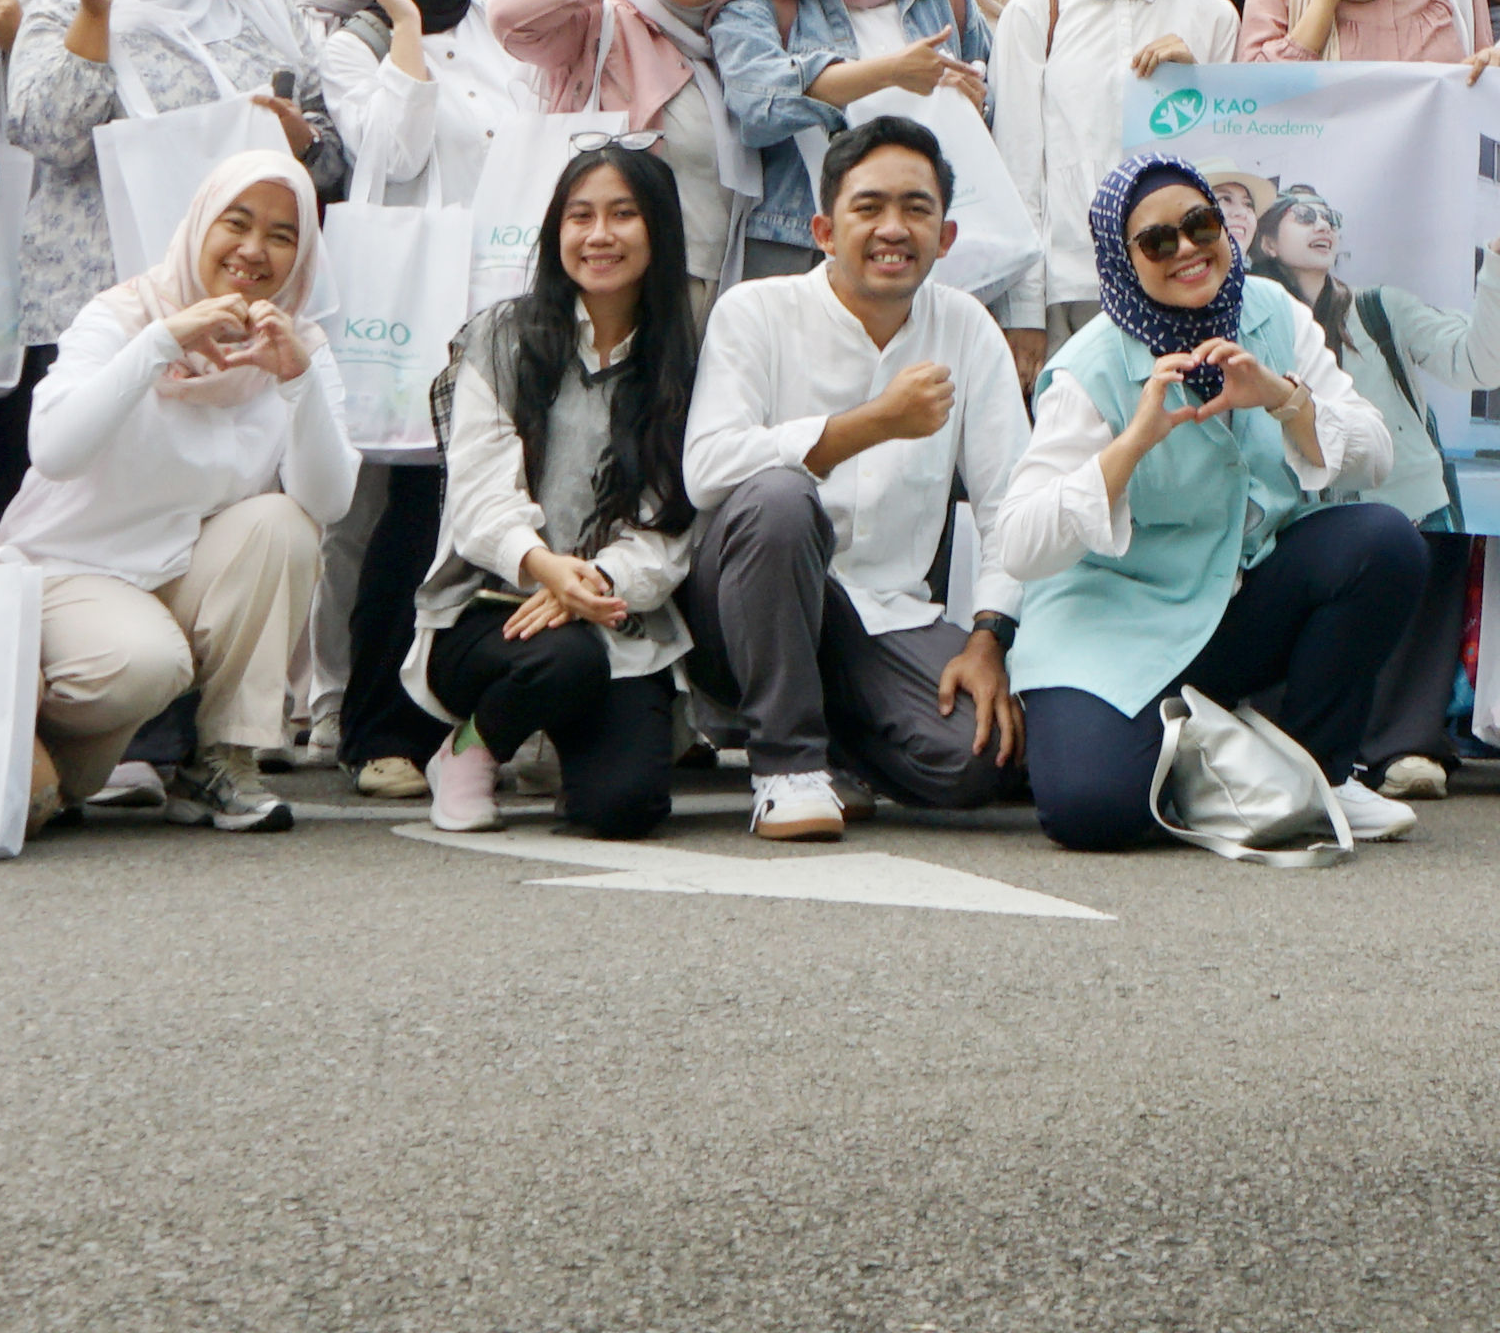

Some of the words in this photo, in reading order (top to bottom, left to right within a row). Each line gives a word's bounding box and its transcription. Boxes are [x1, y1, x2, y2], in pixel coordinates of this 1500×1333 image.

[1213, 98, 1258, 115] KAO
[1213, 119, 1243, 135] Life
[1247, 119, 1324, 138] Academy
[344, 317, 412, 347] kao
